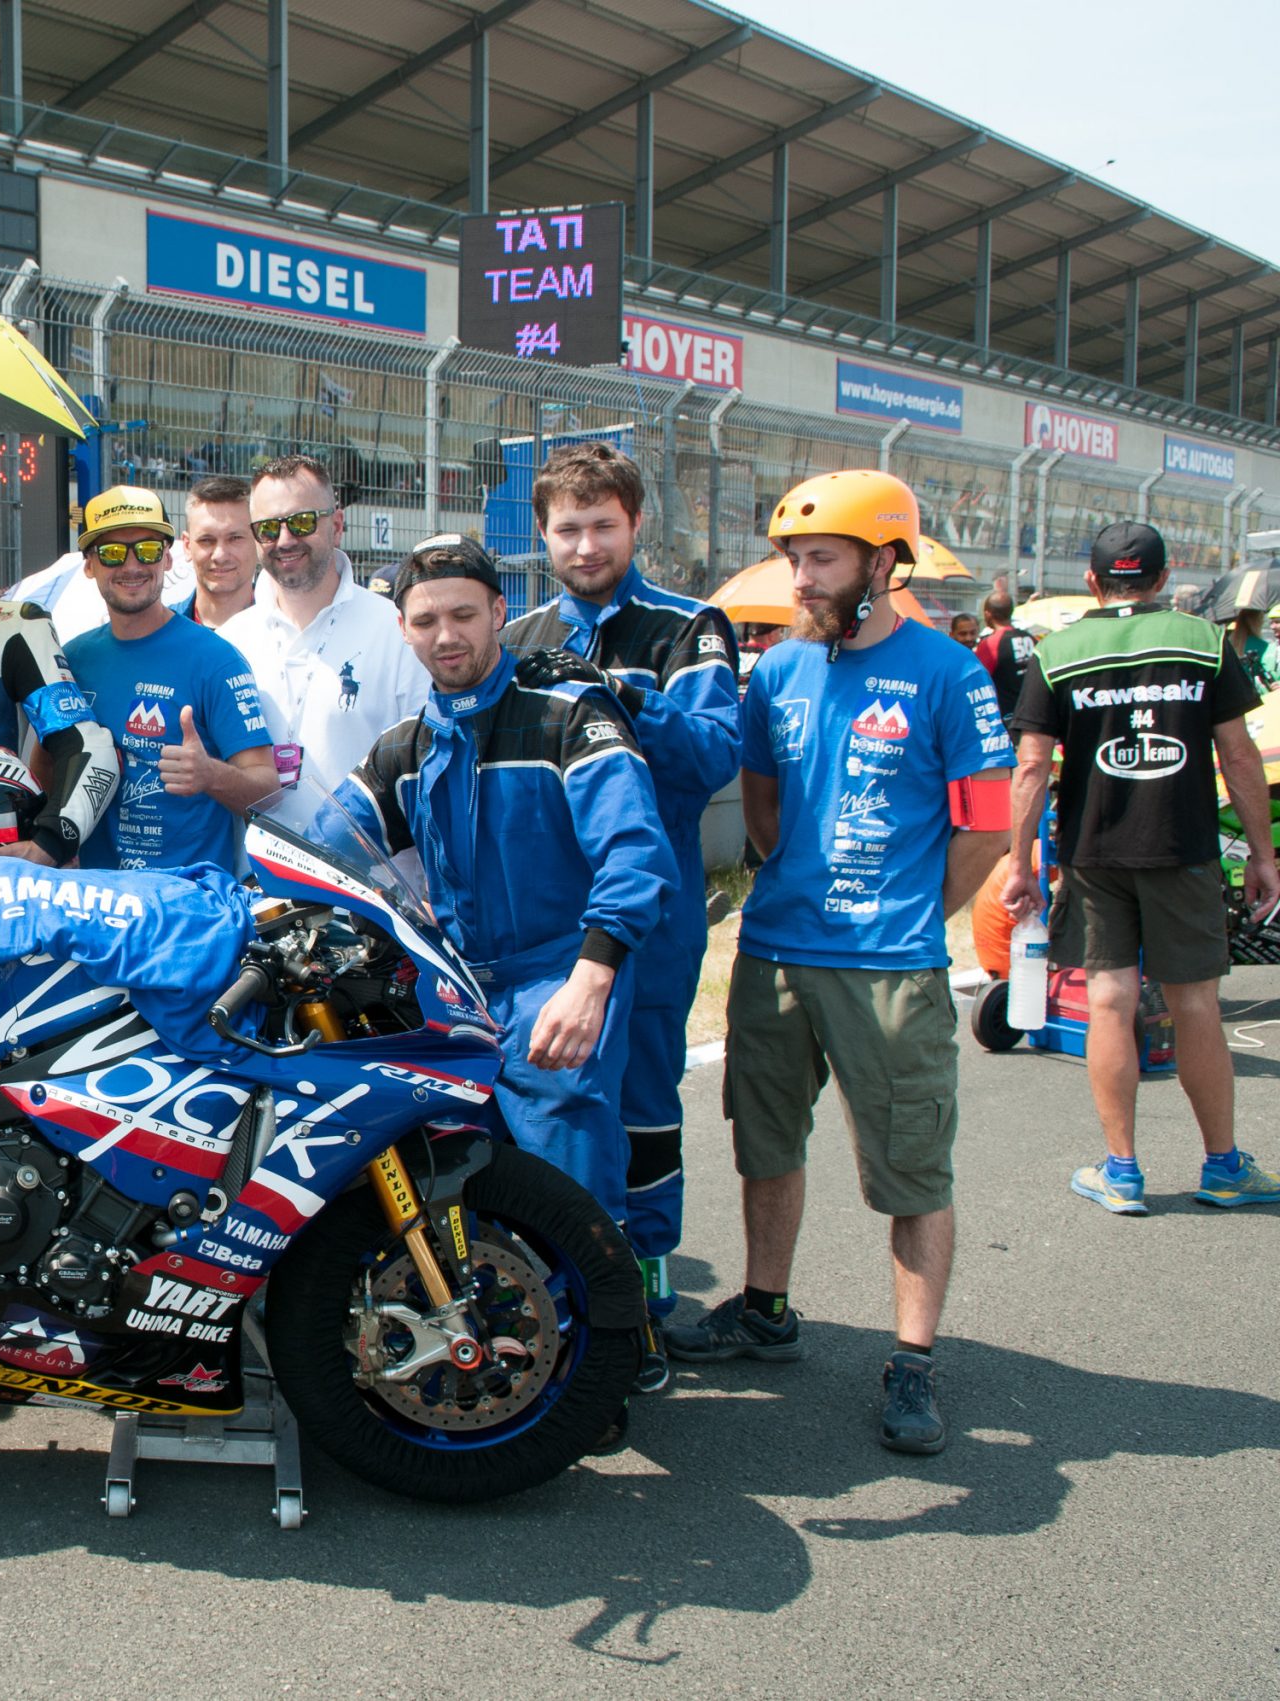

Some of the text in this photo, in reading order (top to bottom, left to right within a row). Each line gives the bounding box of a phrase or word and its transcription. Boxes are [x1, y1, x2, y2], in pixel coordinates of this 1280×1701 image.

[495, 214, 584, 254] TATI
[216, 242, 375, 315] DIESEL
[484, 263, 593, 304] TEAM
[515, 322, 561, 358] #4
[621, 320, 735, 386] HOYER
[840, 381, 961, 418] www.hoyer-energie.de
[1053, 414, 1115, 459] HOYER
[1166, 444, 1235, 481] LPG AUTOGAS
[103, 504, 153, 517] DUNLOP
[375, 517, 390, 544] 12
[144, 683, 175, 697] YAMAHA
[878, 679, 918, 695] YAMAHA
[1071, 679, 1205, 710] Kawasaki
[452, 697, 478, 711] OMP
[129, 723, 162, 733] MERCURY
[858, 723, 903, 735] MERCURY
[1130, 709, 1155, 729] #4
[121, 769, 164, 805] Wójcik
[840, 779, 890, 818] Wójcik
[118, 823, 163, 836] UHMA BIKE
[125, 848, 162, 856] DUNLOP
[266, 848, 294, 865] UHMA
[865, 843, 888, 853] BIKE
[841, 867, 880, 876] DUNLOP
[46, 1088, 217, 1150] Racing Team
[223, 1216, 292, 1250] YAMAHA
[452, 1217, 466, 1258] DUNLOP
[213, 1245, 263, 1270] Beta
[144, 1275, 242, 1321] YART
[204, 1286, 236, 1299] SUPPORTED
[125, 1308, 233, 1343] UHMA BIKE
[0, 1345, 78, 1371] MERCURY
